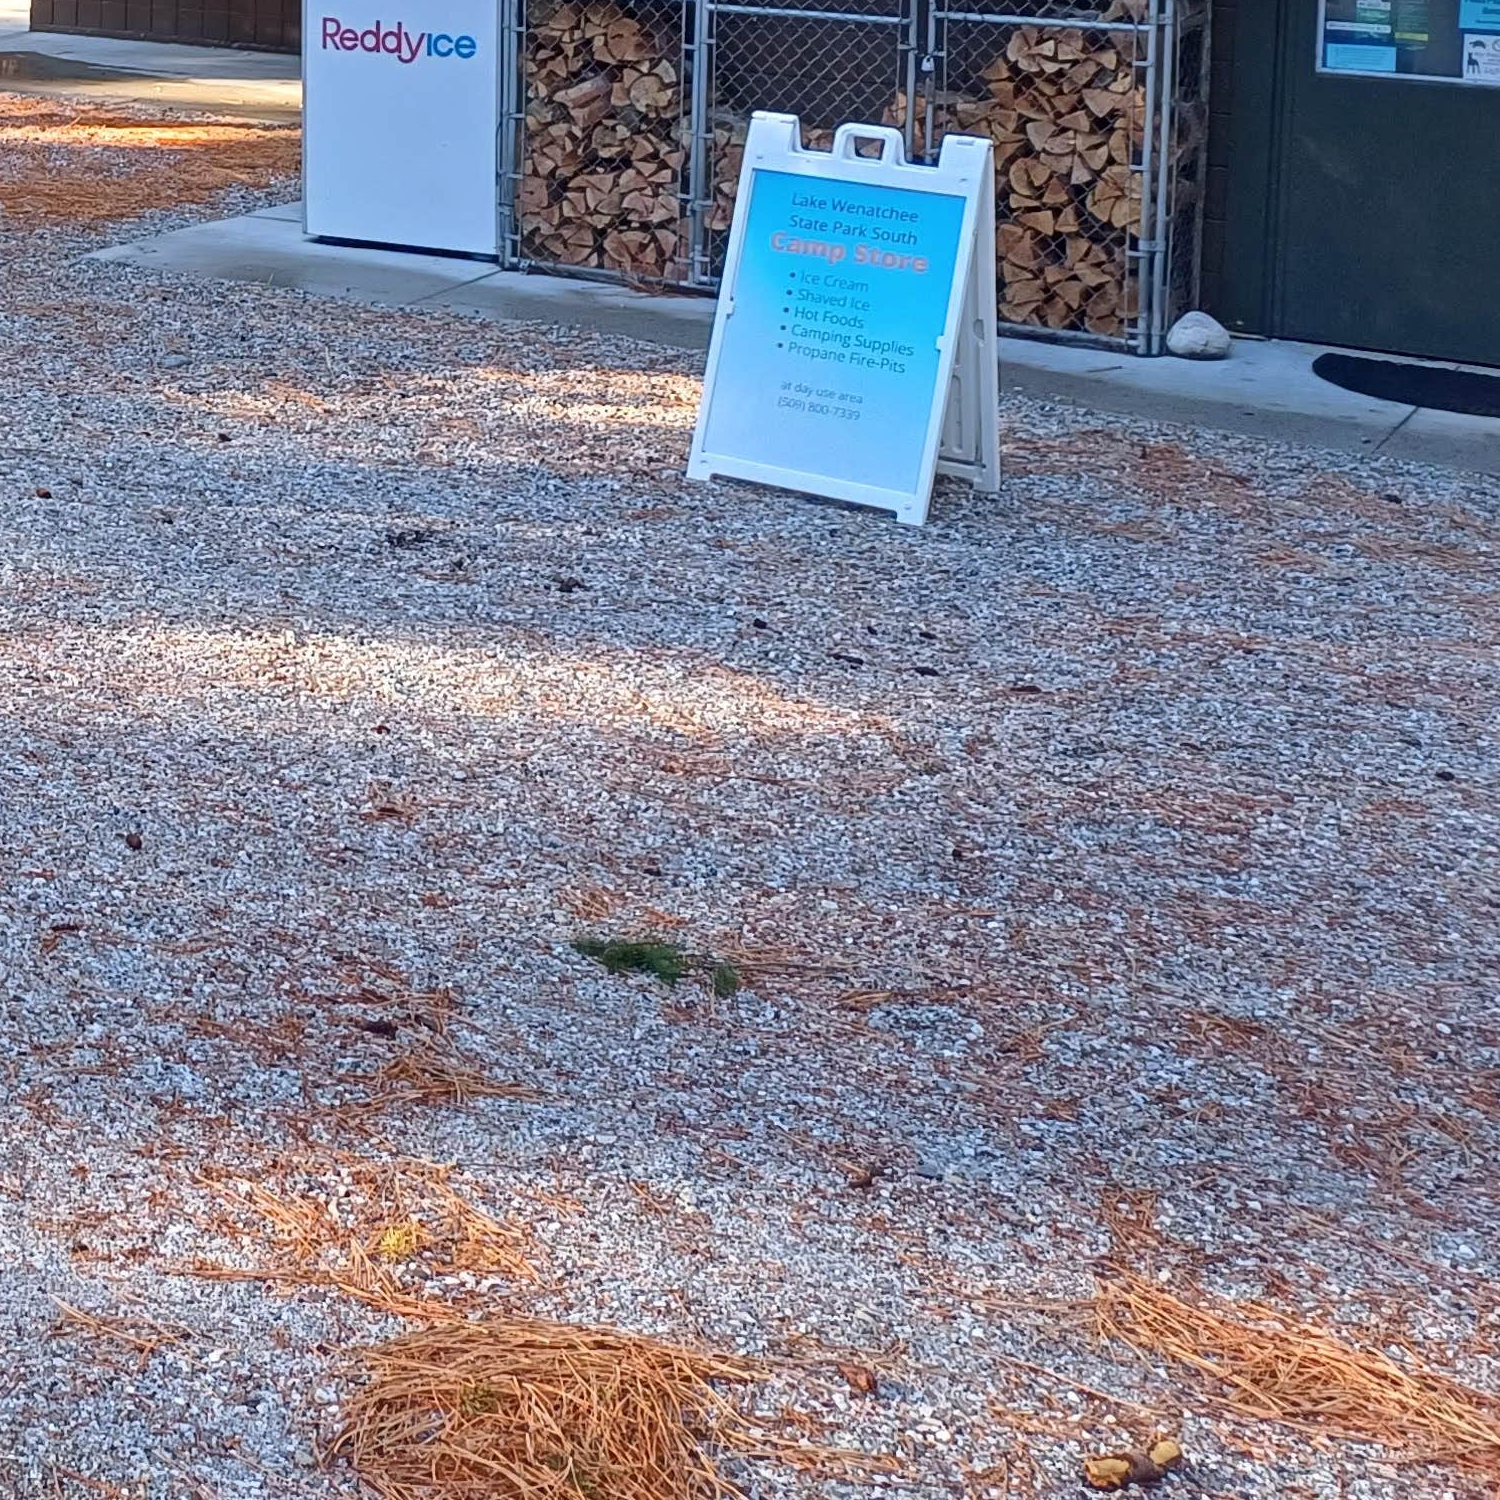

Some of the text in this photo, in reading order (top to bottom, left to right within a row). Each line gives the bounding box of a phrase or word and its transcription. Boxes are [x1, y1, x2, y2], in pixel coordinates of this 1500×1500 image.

[791, 193, 919, 223] Lake Wenatchee
[789, 214, 918, 246] State Park South
[770, 230, 929, 273] Camp Store
[800, 271, 869, 293] Ice Cream
[797, 288, 870, 312] Shaved Ice
[794, 306, 865, 329] Hot Foods
[790, 323, 915, 357] Camping Supplies
[788, 341, 906, 374] Propane Fire-Pits
